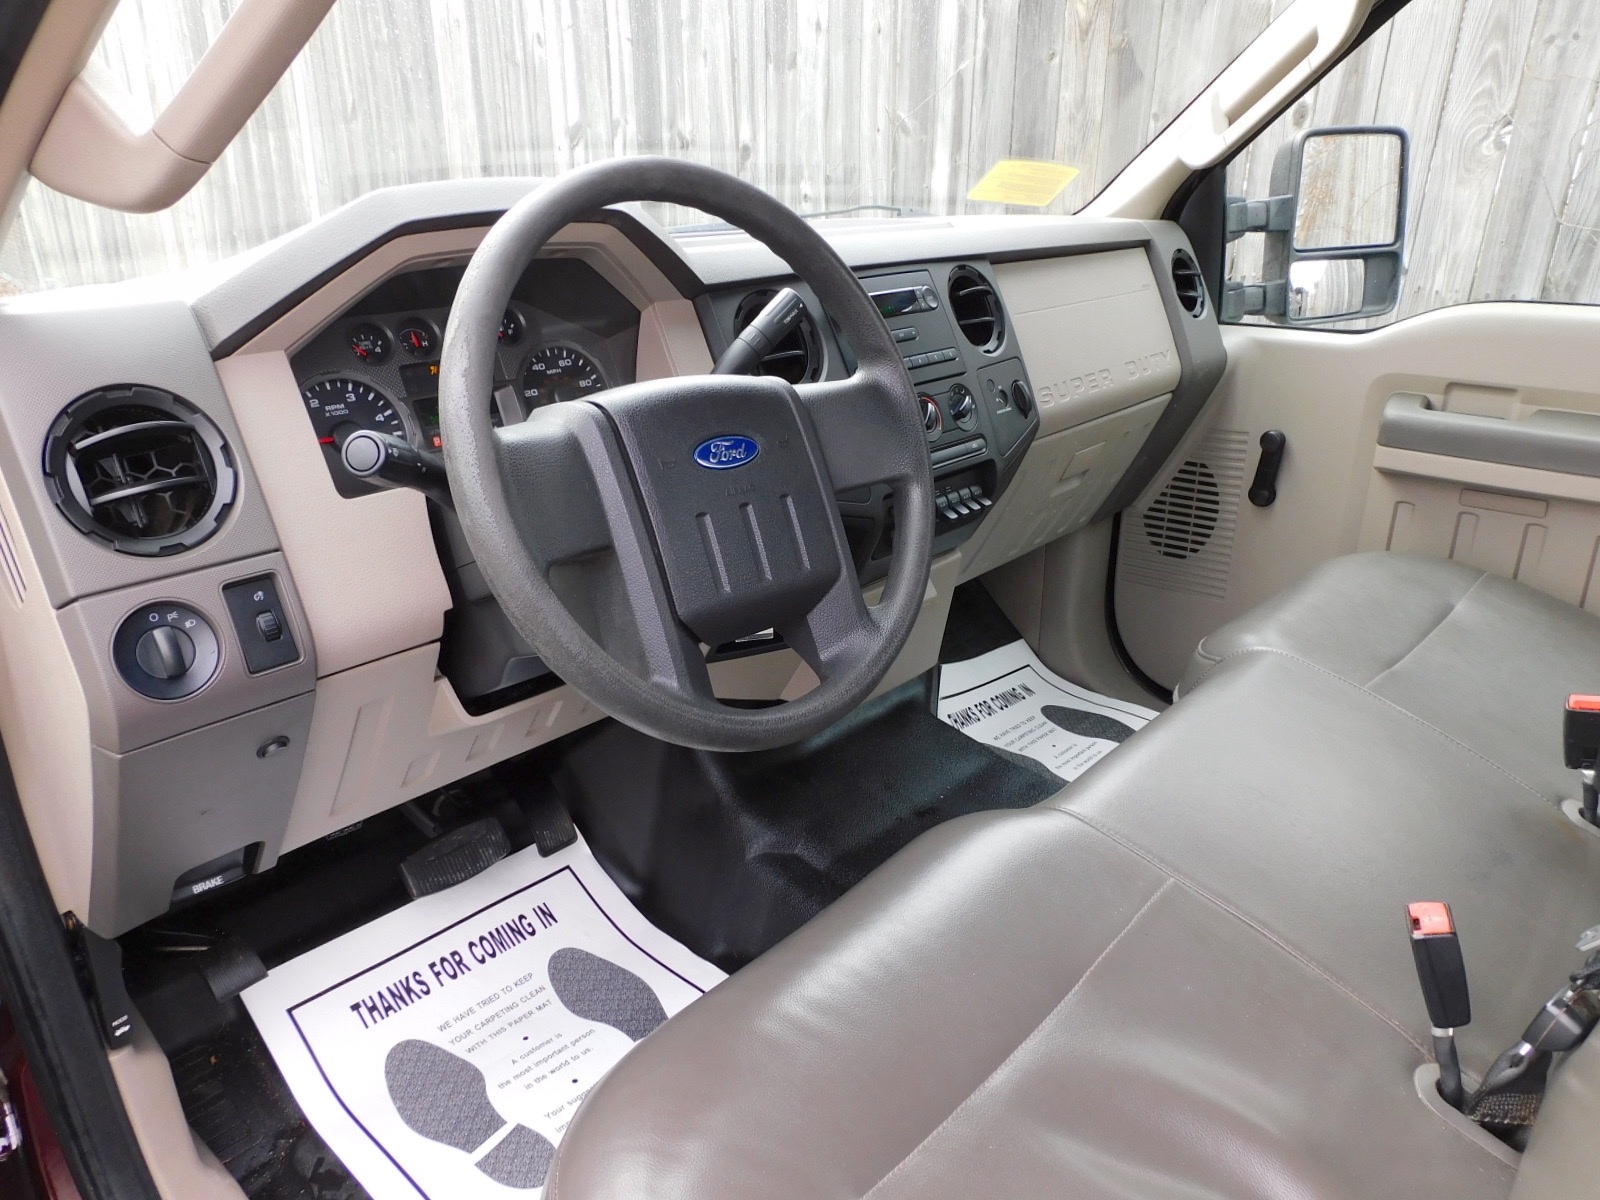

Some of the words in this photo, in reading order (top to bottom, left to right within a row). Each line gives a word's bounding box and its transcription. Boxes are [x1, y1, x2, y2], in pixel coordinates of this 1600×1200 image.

[532, 363, 546, 371] 40
[559, 359, 572, 367] 60
[579, 379, 592, 388] 80
[1038, 368, 1114, 408] SUPER
[1124, 350, 1170, 381] DUTY
[309, 398, 320, 409] 2
[345, 393, 356, 402] 3
[524, 389, 538, 397] 20
[324, 403, 345, 411] RPM
[375, 413, 385, 423] 4
[709, 440, 747, 463] Ford
[947, 706, 980, 730] THANKS
[973, 700, 998, 719] FOR
[989, 687, 1027, 711] COMING
[1017, 682, 1036, 698] IN
[192, 875, 224, 894] BRAKE
[350, 971, 431, 1029] THANKS
[428, 950, 471, 987] FOR
[468, 914, 536, 965] COMING
[532, 902, 558, 929] IN
[437, 1020, 453, 1032] WE
[453, 1006, 476, 1023] HAVE
[476, 993, 500, 1010] TRIED
[501, 985, 513, 995] TO
[513, 972, 533, 987] KEEP
[448, 1029, 474, 1046] YOUR
[474, 1001, 519, 1031] CARPETING
[520, 985, 546, 1003] CLEAN
[465, 1038, 488, 1054] WITH
[488, 1027, 507, 1040] THIS
[507, 1010, 535, 1028] PAPER
[535, 999, 553, 1012] MAT
[497, 1079, 512, 1090] the
[513, 1065, 533, 1081] most
[533, 1044, 570, 1068] important
[570, 1028, 595, 1047] person
[520, 1037, 554, 1060] customer
[523, 1082, 534, 1090] in
[534, 1074, 548, 1084] the
[548, 1060, 570, 1074] world
[570, 1054, 580, 1062] to
[544, 1105, 565, 1120] Your
